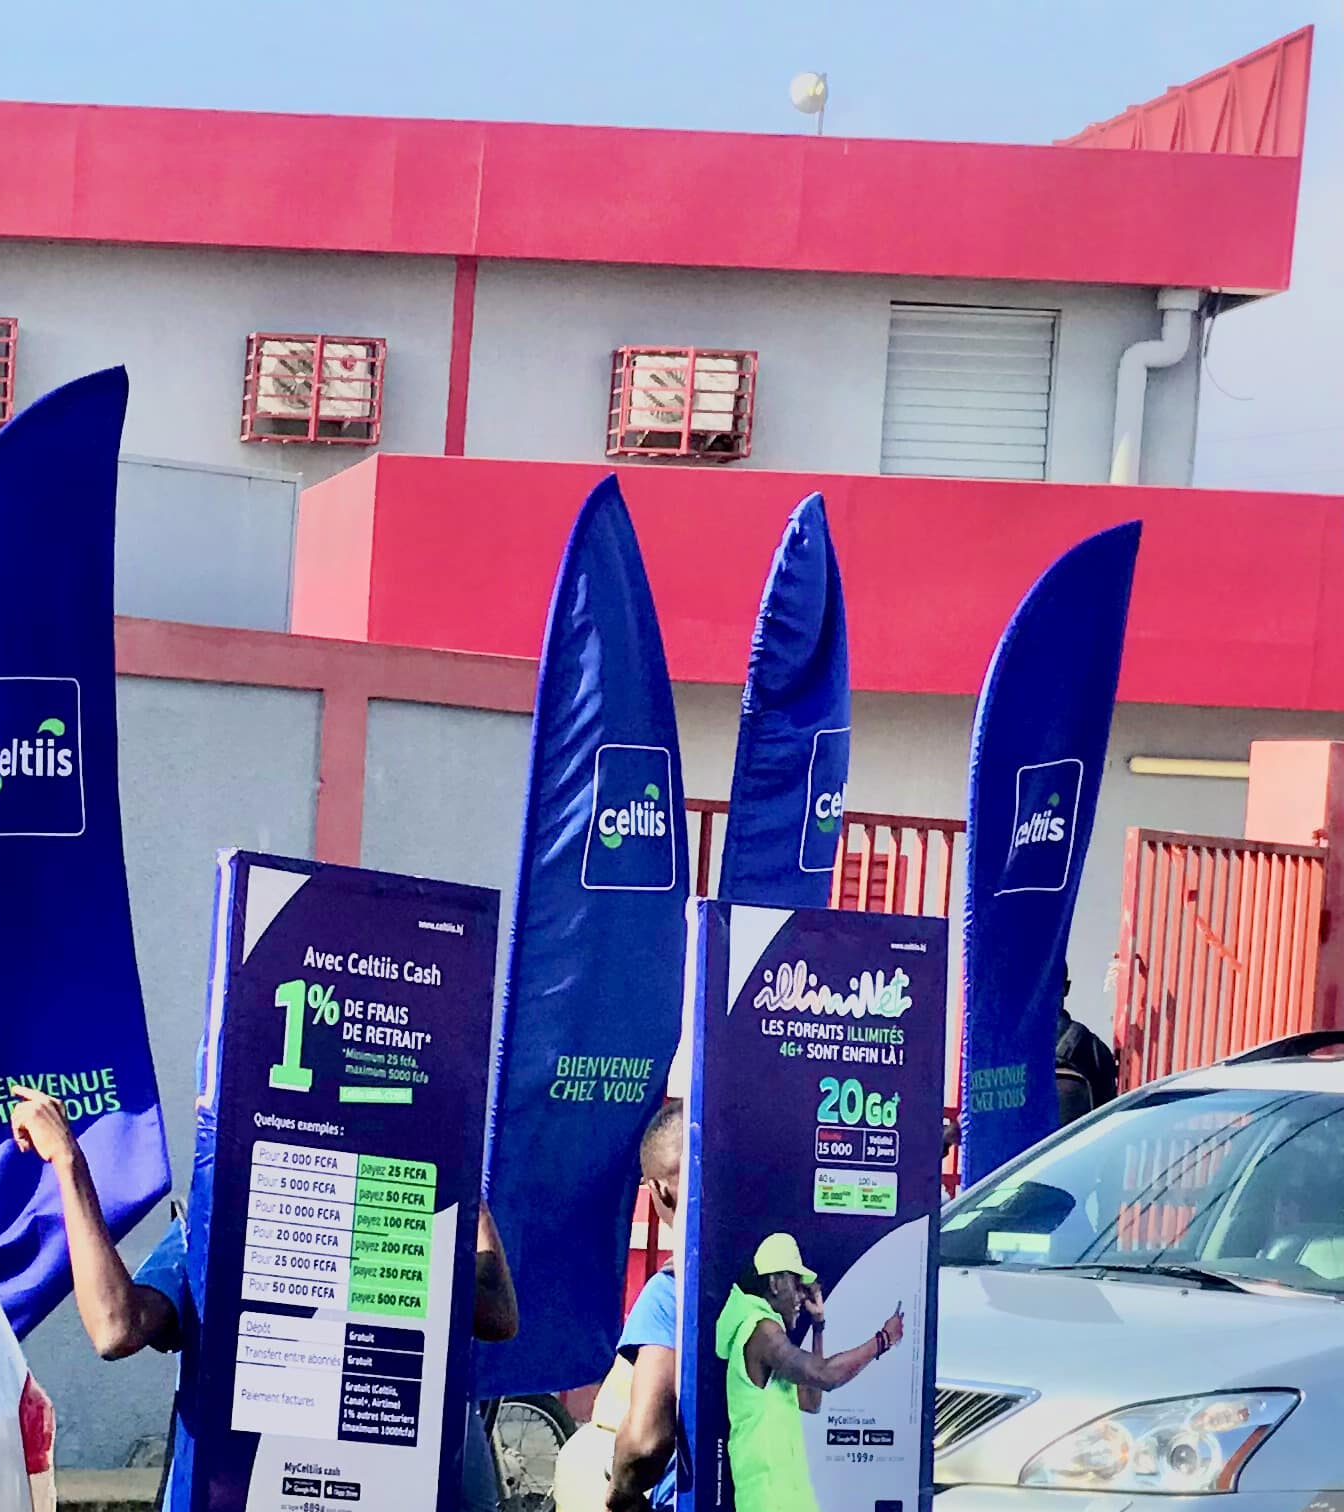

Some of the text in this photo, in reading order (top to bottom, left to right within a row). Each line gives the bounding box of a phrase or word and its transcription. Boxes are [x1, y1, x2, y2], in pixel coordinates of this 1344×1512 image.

[598, 800, 666, 839] celtiis
[303, 946, 442, 986] Avec Celtiis Cash
[344, 999, 408, 1025] DE FRAIS
[342, 1022, 362, 1042] DE
[761, 1018, 904, 1044] LES FORFAITS ILLIMITÉS
[387, 1054, 398, 1065] 25
[779, 1041, 896, 1065] 4G+ SONT ENFIN LÀ
[388, 1068, 411, 1081] 5000
[556, 1055, 654, 1079] BIENVENUE
[549, 1080, 648, 1103] CHEZ VOUS
[816, 1076, 863, 1125] 20
[63, 1091, 121, 1121] OUS
[254, 1112, 339, 1135] Quelques exemples
[818, 1142, 853, 1156] 15 000
[282, 1151, 427, 1181] 2 000 FCFA 25 FCFA
[279, 1203, 427, 1232] 10 000 FCFA 100 FCFA
[272, 1281, 421, 1308] 50 000 FCFA 500 FCFA
[349, 1331, 375, 1344] Gratuit
[347, 1355, 373, 1368] Gratuit
